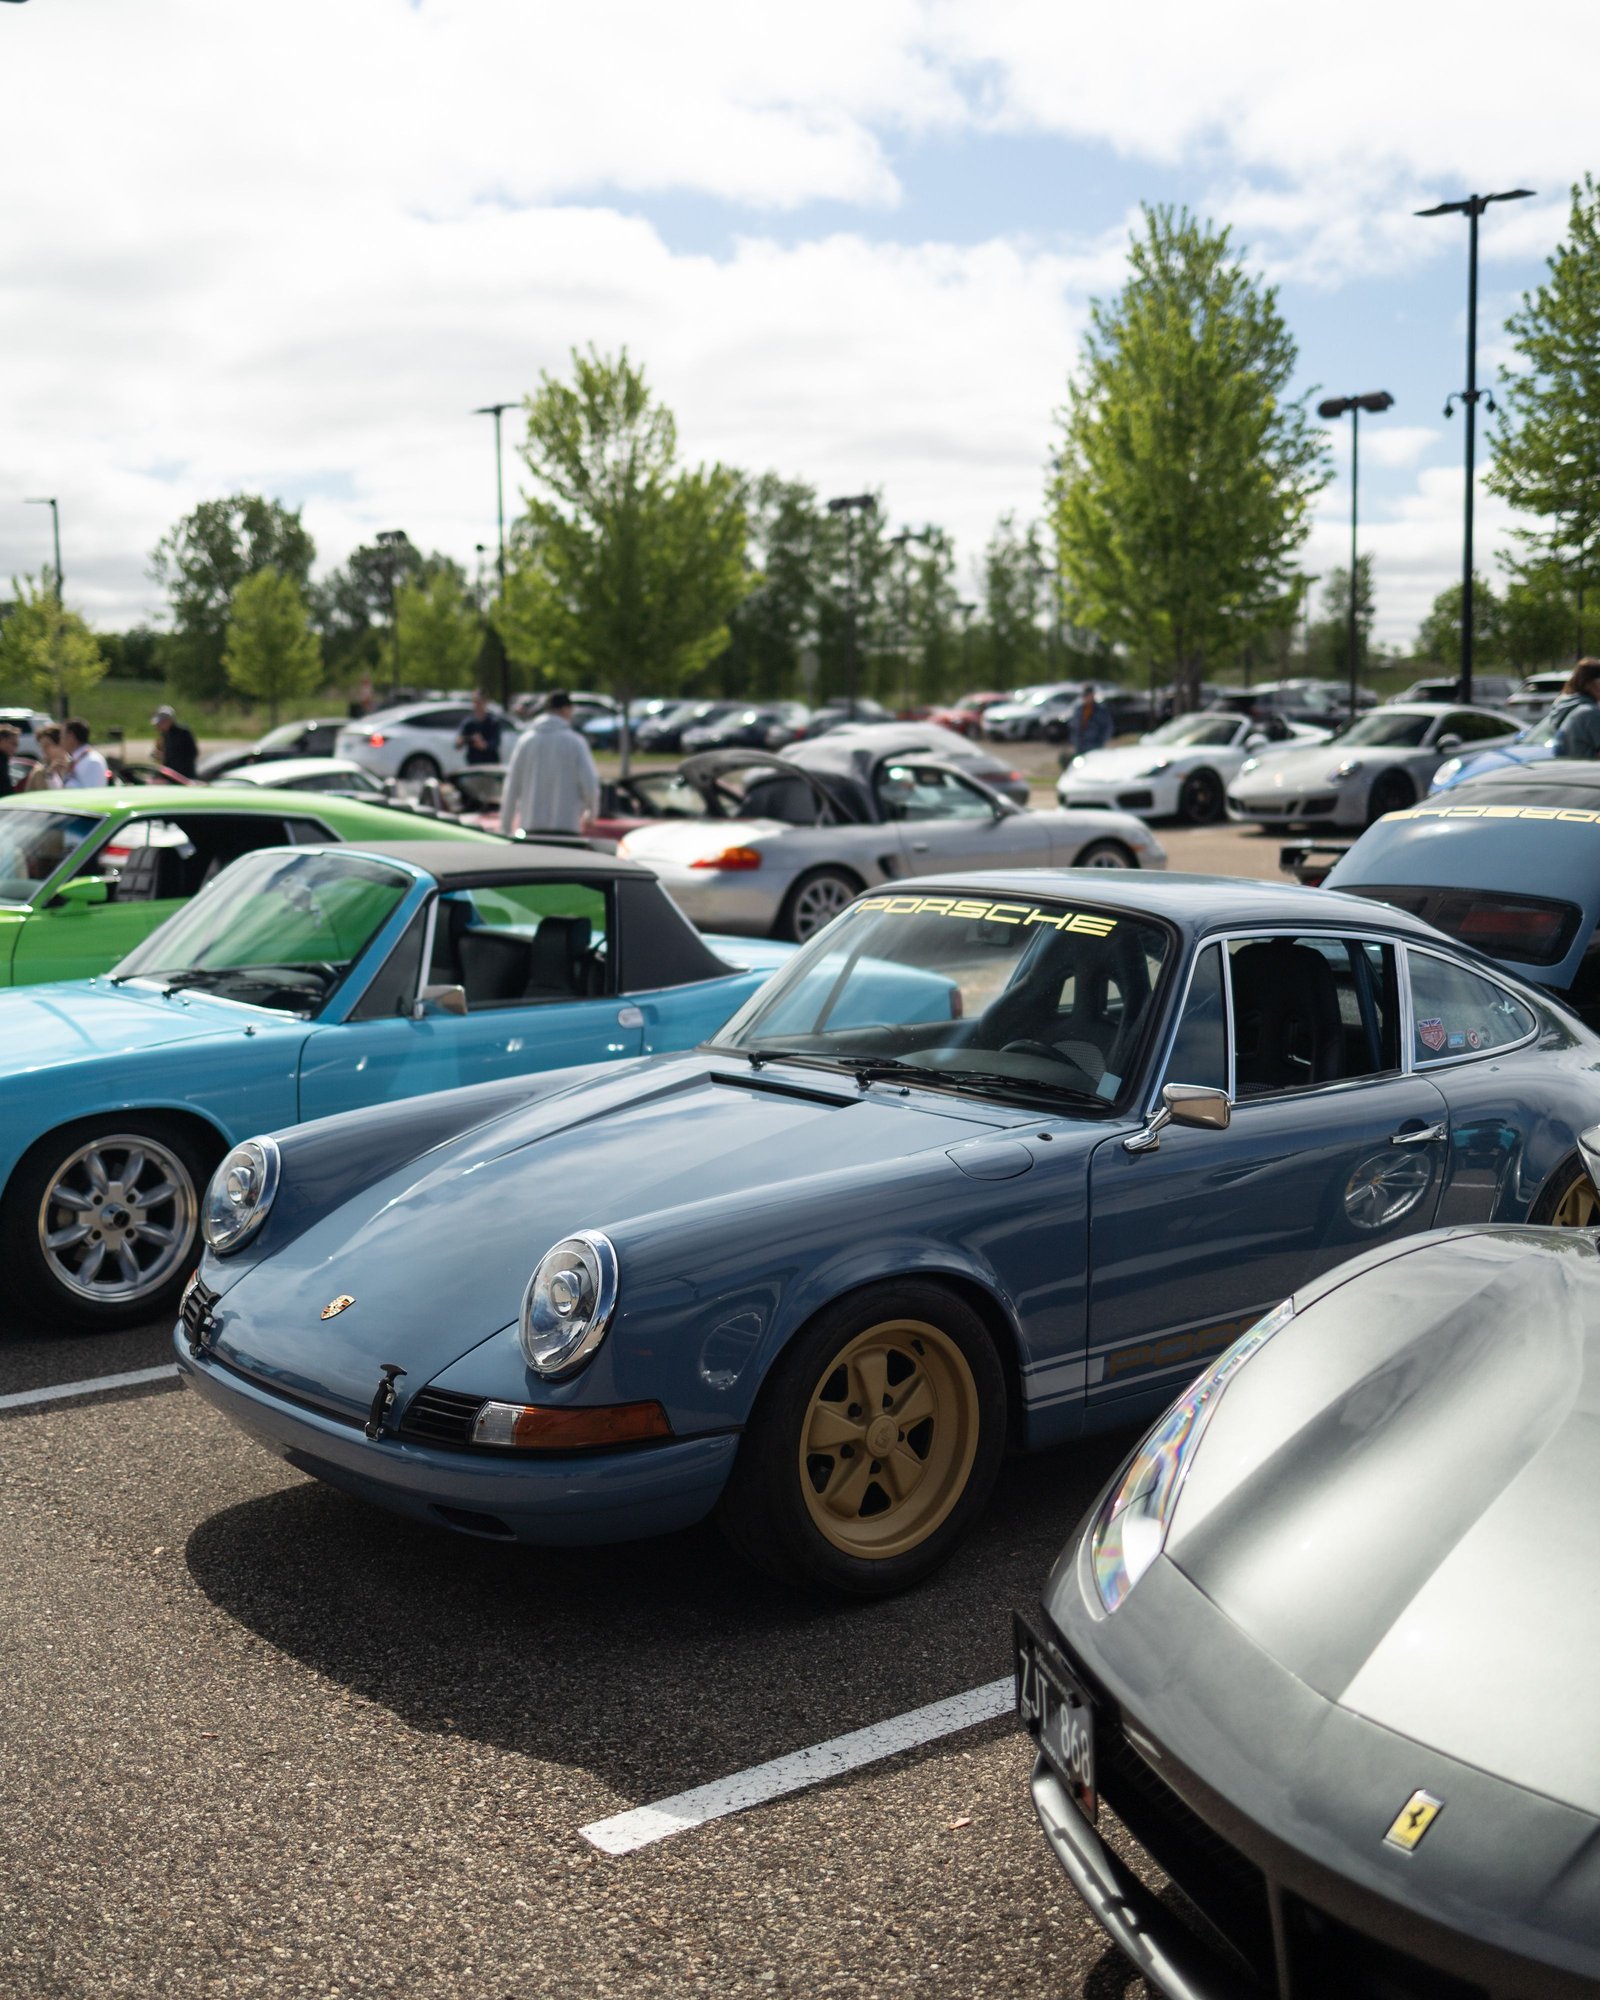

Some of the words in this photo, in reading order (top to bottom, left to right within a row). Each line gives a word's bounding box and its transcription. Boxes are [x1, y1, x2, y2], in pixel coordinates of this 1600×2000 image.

[855, 898, 1117, 937] PORSCHE
[1020, 1648, 1048, 1729] ZJT
[1060, 1703, 1091, 1787] 868
